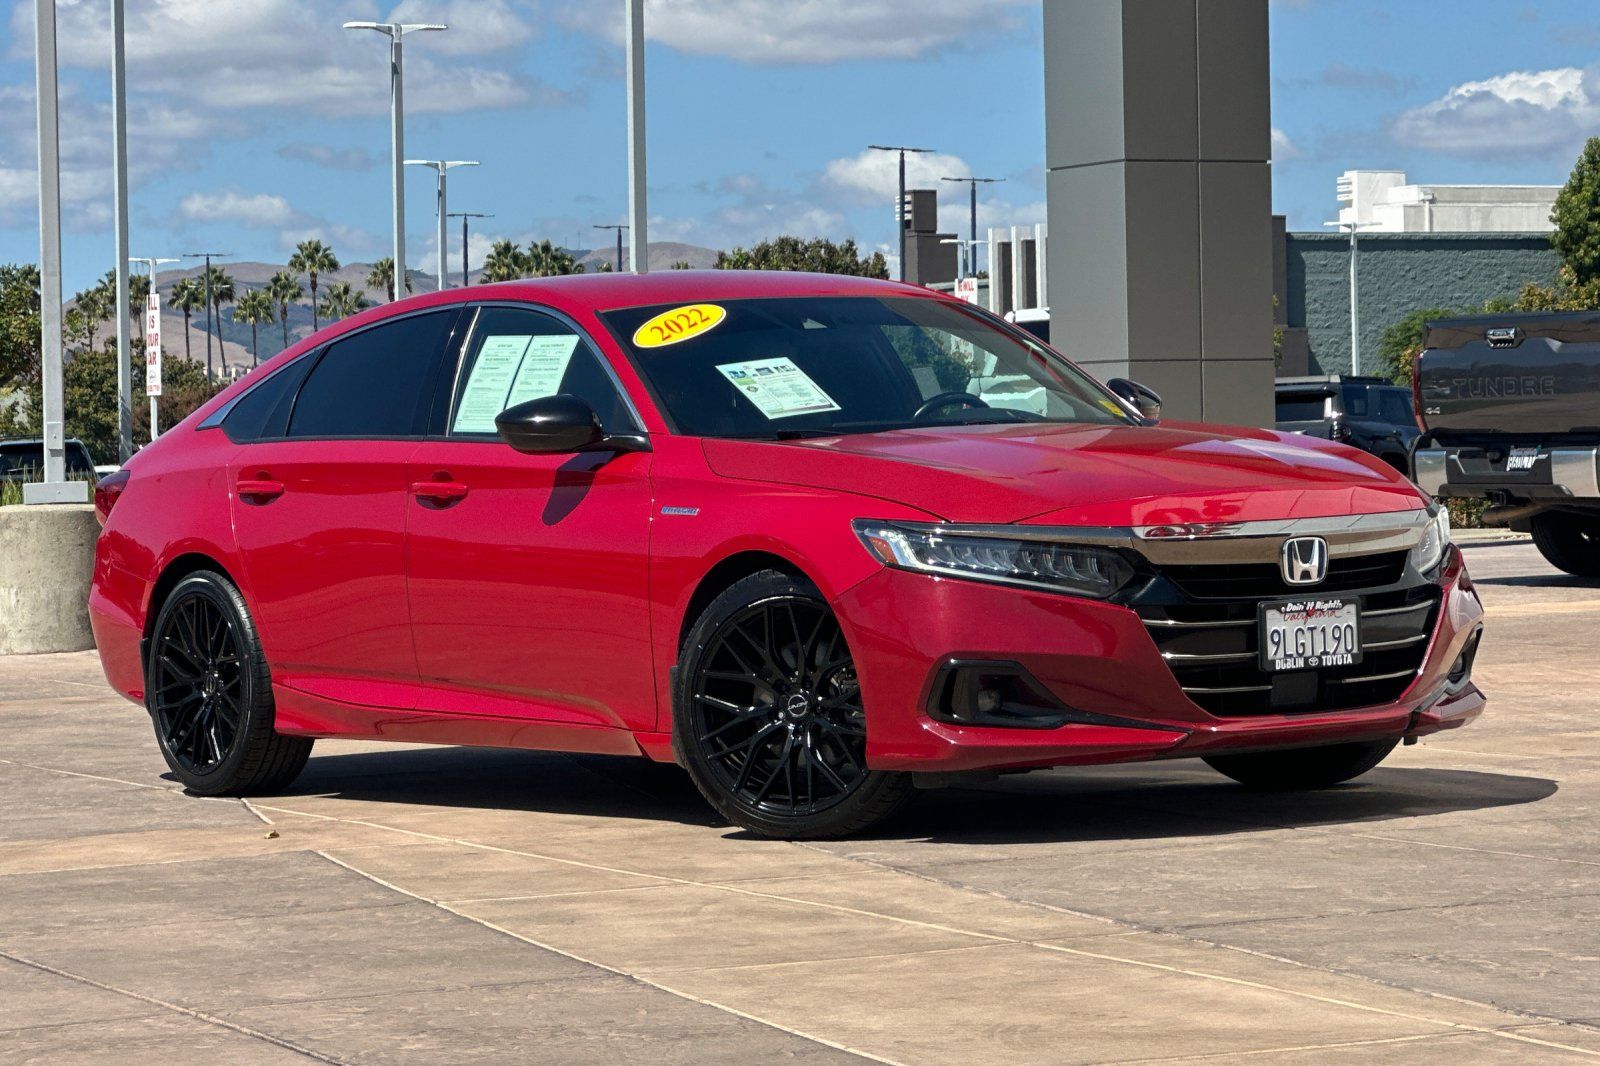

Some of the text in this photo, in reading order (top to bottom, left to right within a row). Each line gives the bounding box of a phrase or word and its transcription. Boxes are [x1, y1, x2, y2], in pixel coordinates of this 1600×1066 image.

[650, 308, 710, 342] 2022
[1452, 376, 1556, 400] TUNDRA
[1270, 622, 1355, 659] 9LGT190
[1275, 653, 1353, 670] DUBLIN TOYOTA
